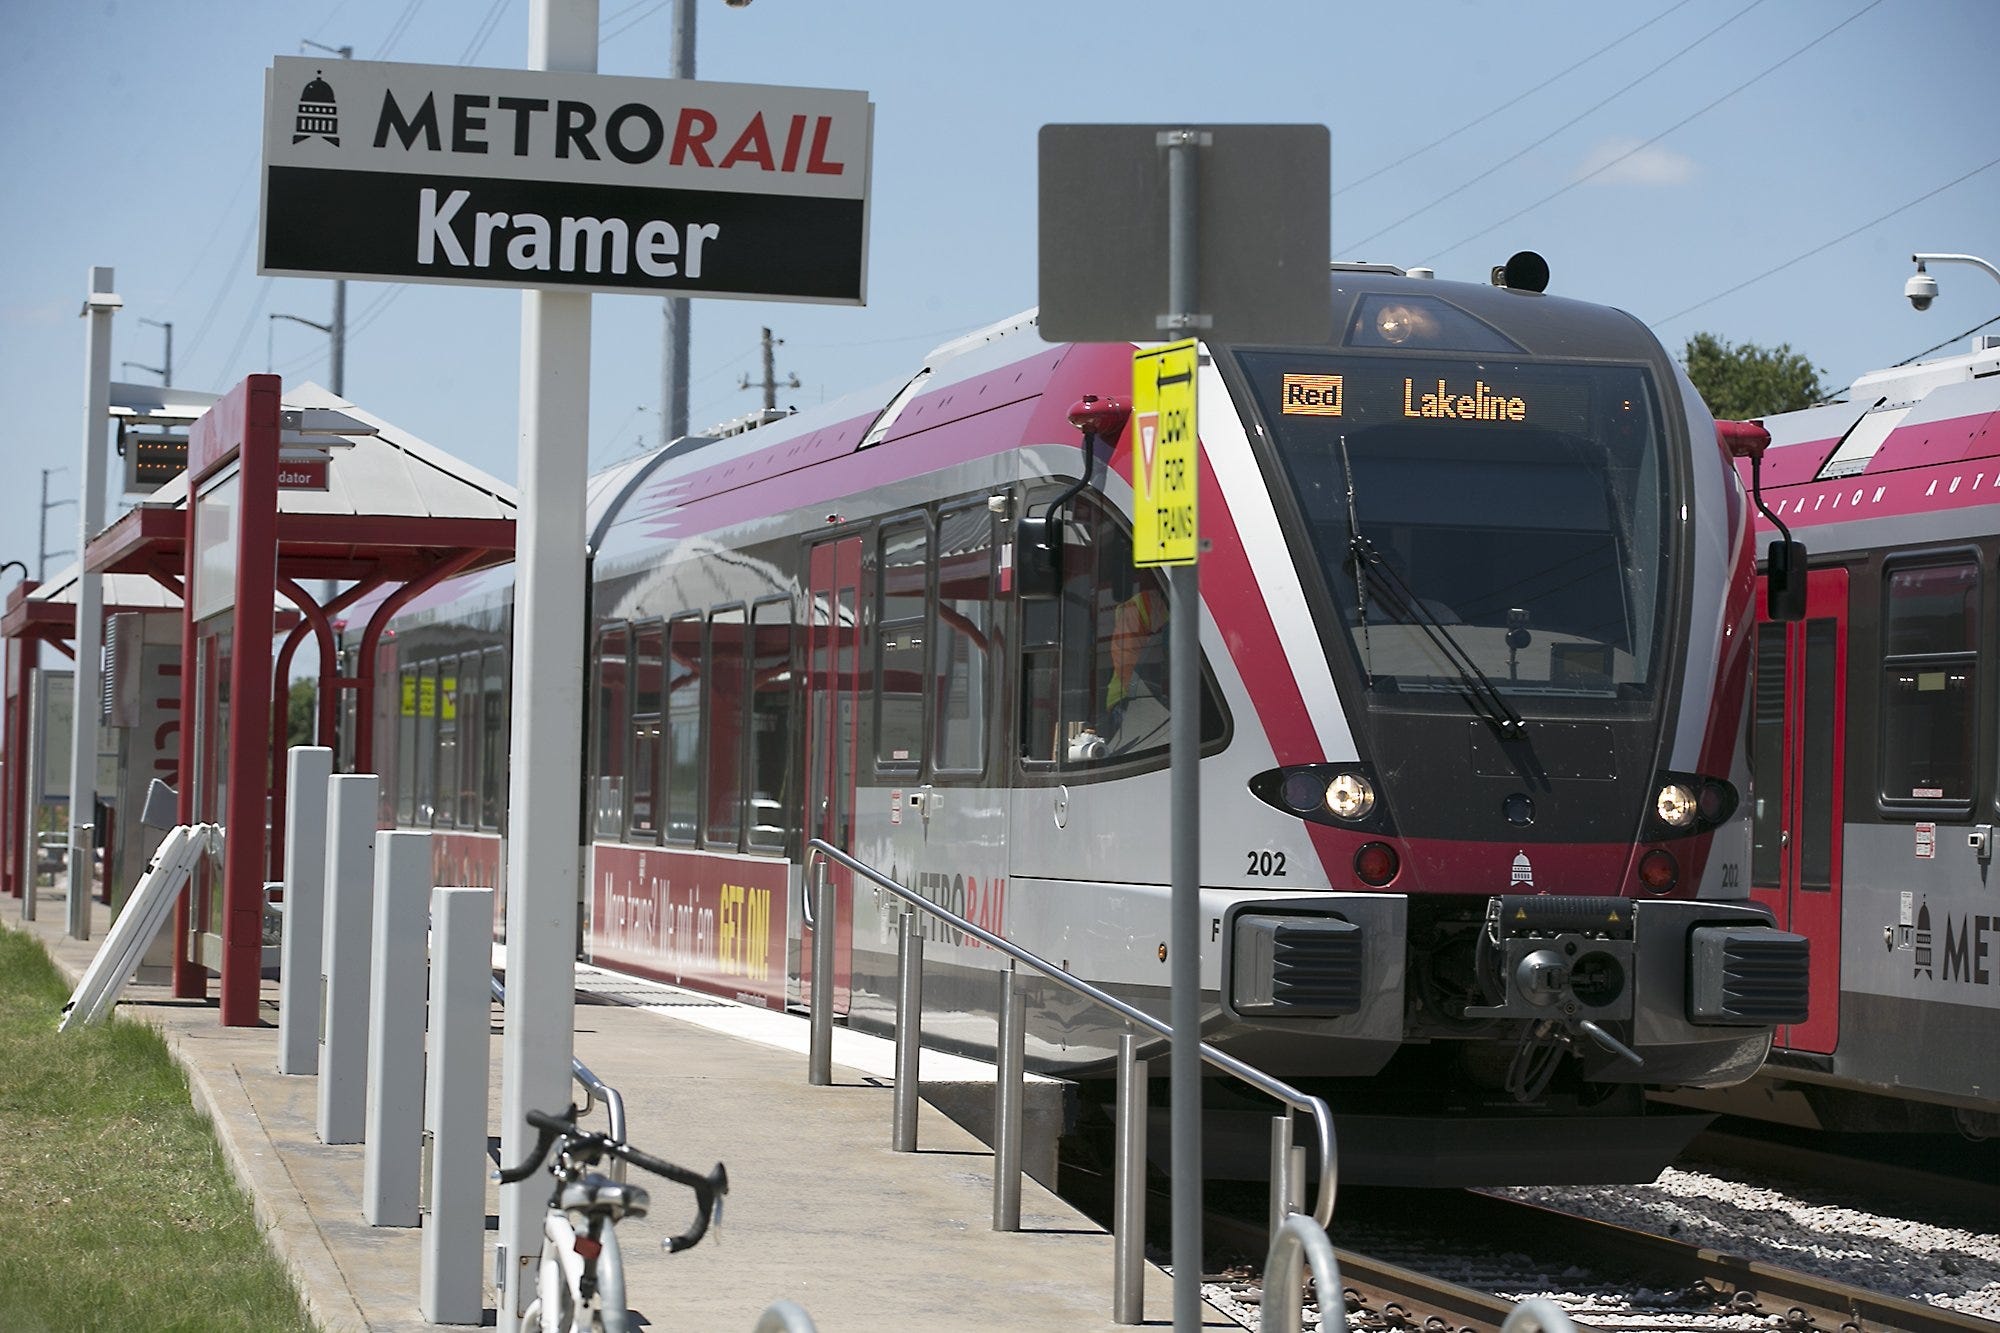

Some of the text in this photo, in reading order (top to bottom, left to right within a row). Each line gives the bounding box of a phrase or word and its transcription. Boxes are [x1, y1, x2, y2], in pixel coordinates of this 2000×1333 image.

[372, 87, 844, 176] METRORAIL
[416, 187, 720, 278] Kramer
[1288, 377, 1527, 421] Red Lakeline
[1161, 407, 1190, 444] LOOK
[1164, 457, 1186, 491] FOR
[1157, 505, 1193, 541] TRAINS
[1246, 850, 1287, 876] 202
[1722, 863, 1739, 888] 202
[604, 871, 627, 950] More
[660, 878, 675, 962] We
[676, 885, 694, 985] got
[719, 882, 745, 976] GET
[746, 886, 771, 983] ON!
[905, 871, 1008, 949] METRORAIL
[1211, 918, 1221, 942] F
